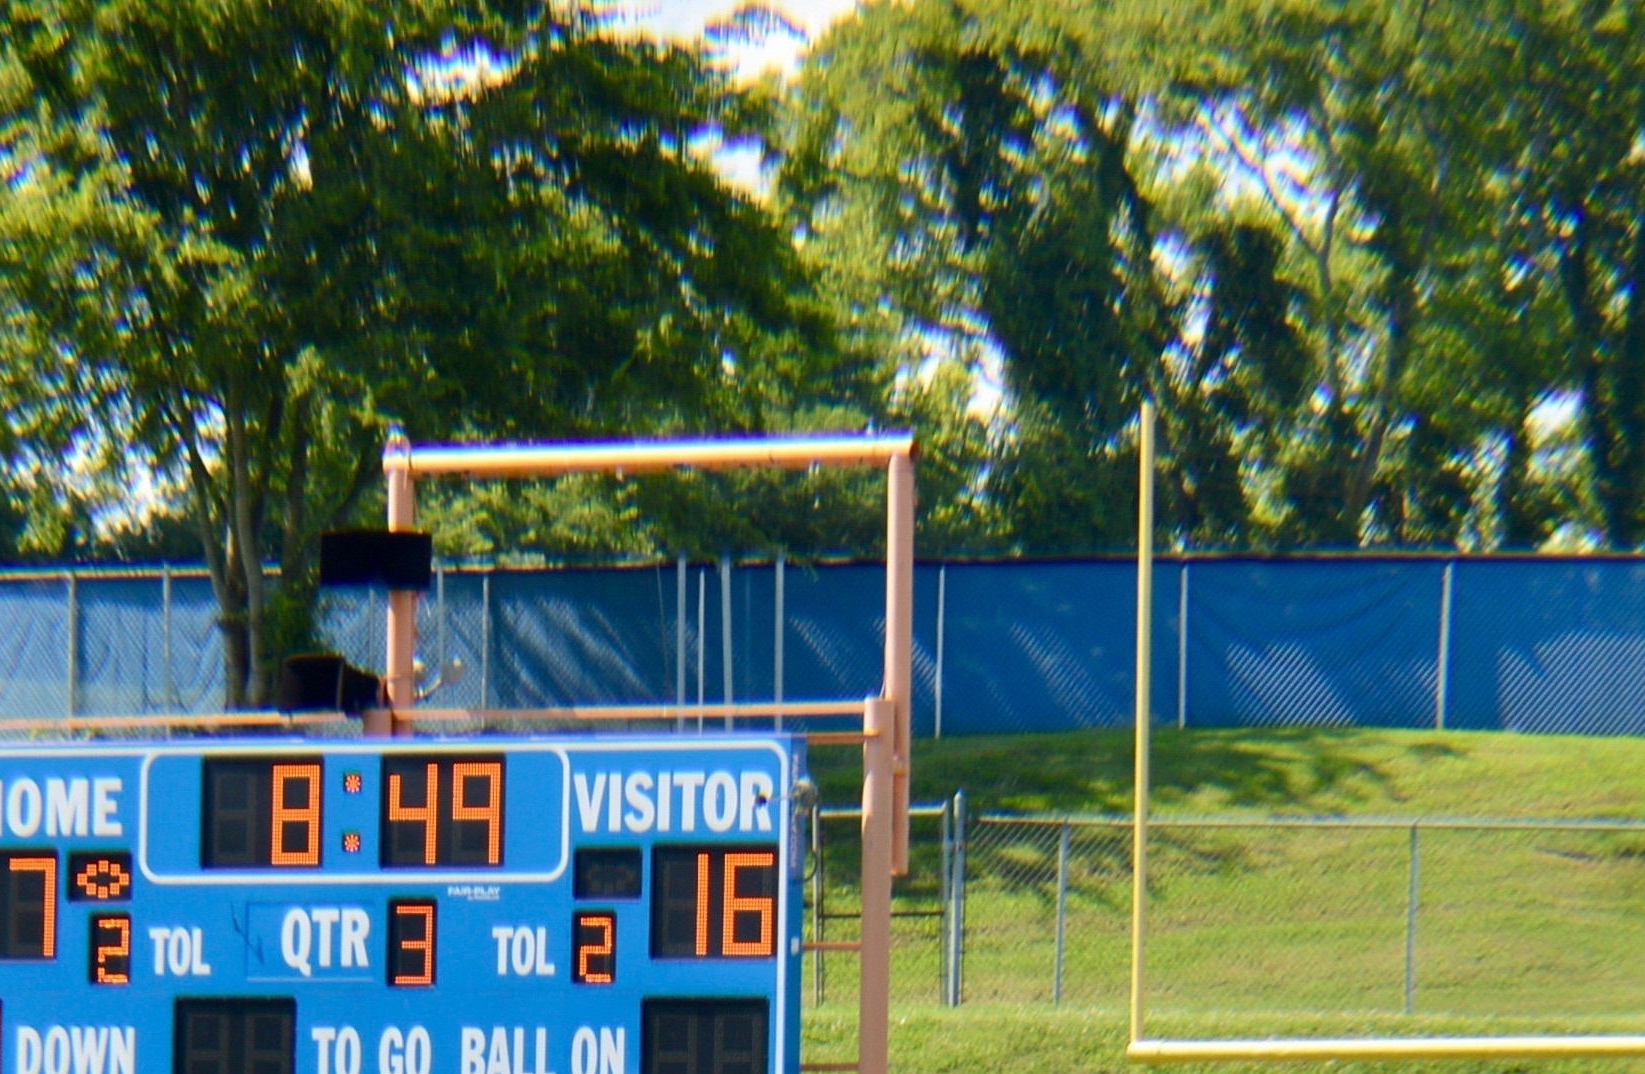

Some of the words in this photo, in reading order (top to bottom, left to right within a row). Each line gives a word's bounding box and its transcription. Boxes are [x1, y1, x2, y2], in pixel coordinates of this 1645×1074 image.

[574, 771, 774, 832] VISITOR
[9, 858, 56, 957] 7
[695, 853, 774, 956] 16
[97, 918, 130, 983] 2
[149, 927, 212, 975] TOL
[280, 908, 371, 975] QTR
[395, 905, 434, 985] 3
[493, 926, 555, 975] TOL
[579, 916, 612, 983] 2
